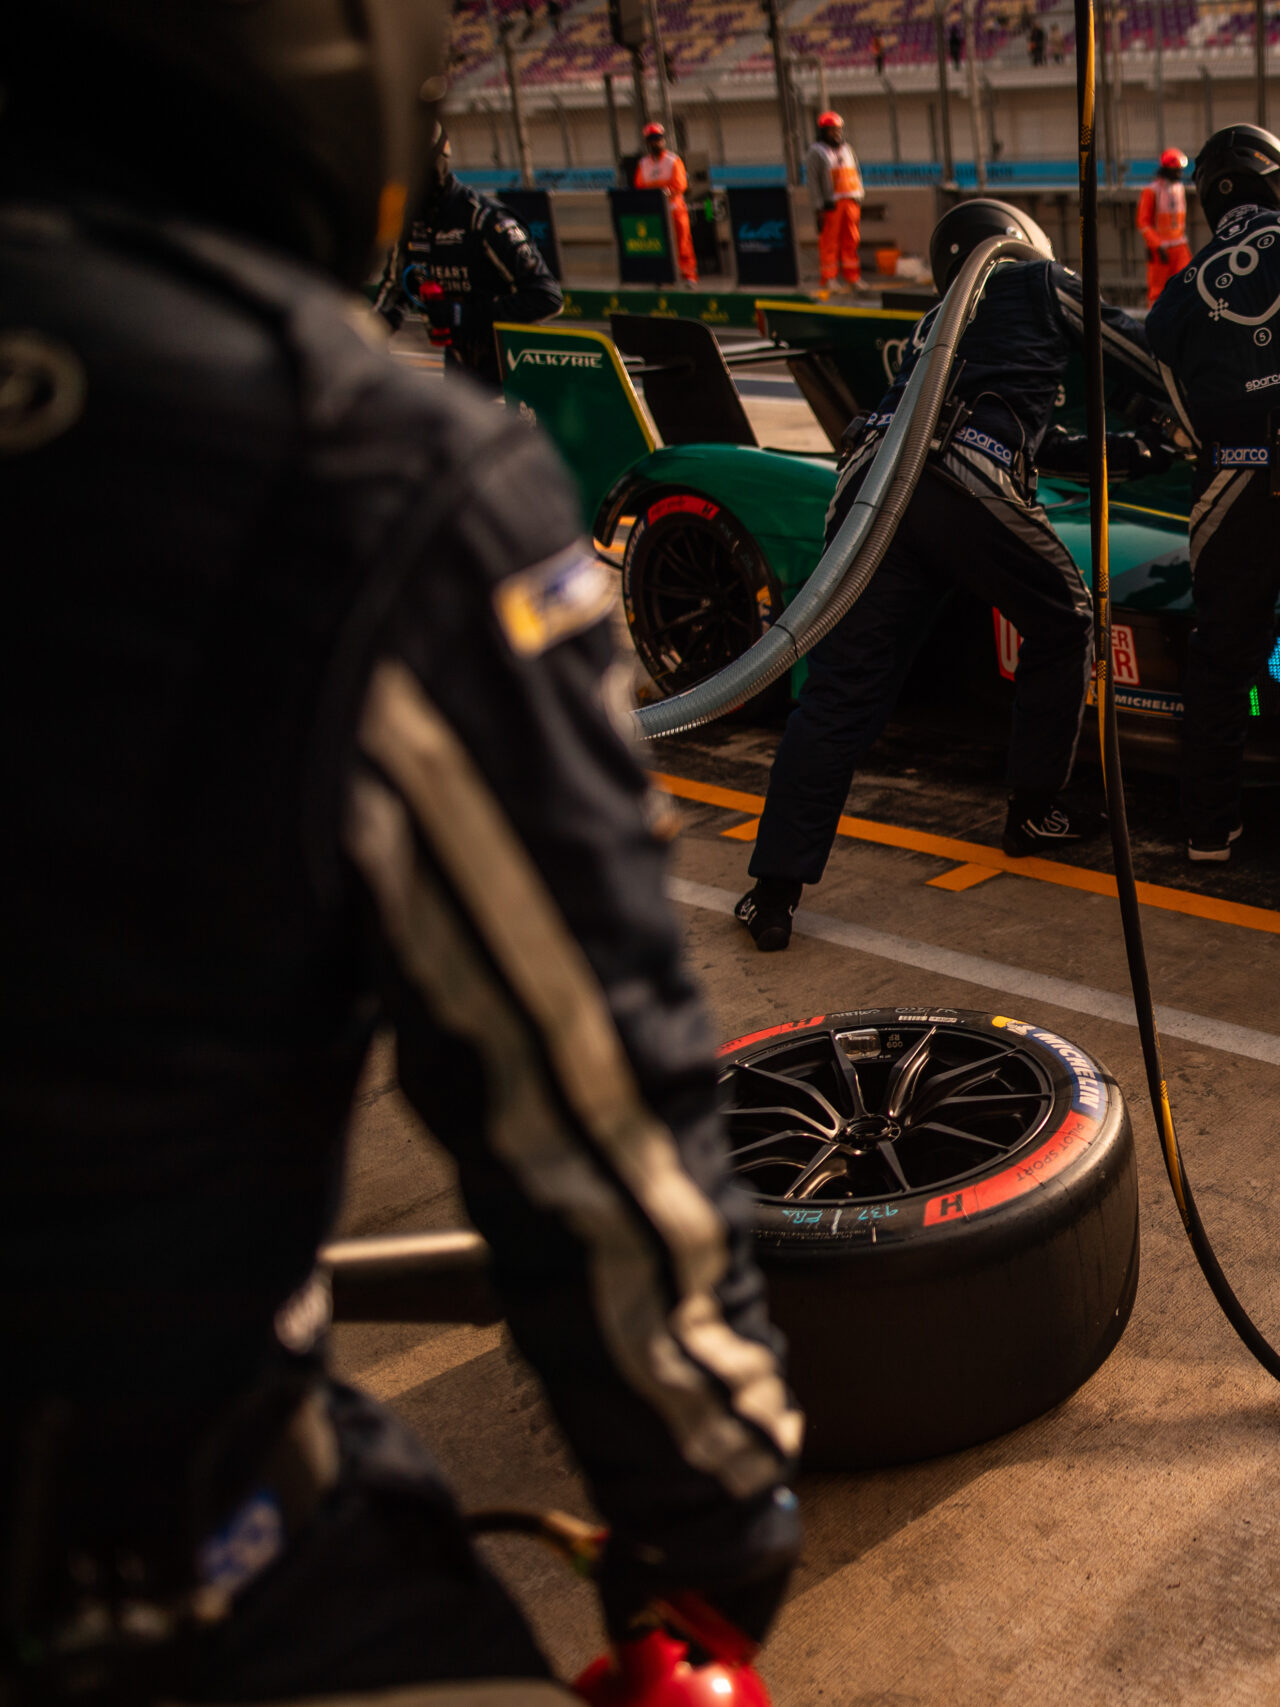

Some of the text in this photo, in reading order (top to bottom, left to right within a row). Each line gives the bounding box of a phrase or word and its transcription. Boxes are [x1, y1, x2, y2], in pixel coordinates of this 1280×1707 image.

[507, 347, 603, 372] VALKYRIE
[1115, 693, 1185, 712] MICHELIN
[1033, 1033, 1100, 1110] MICHELIN
[1016, 1122, 1084, 1182] PILOT SPORT
[857, 1204, 899, 1221] 937
[940, 1194, 963, 1216] H
